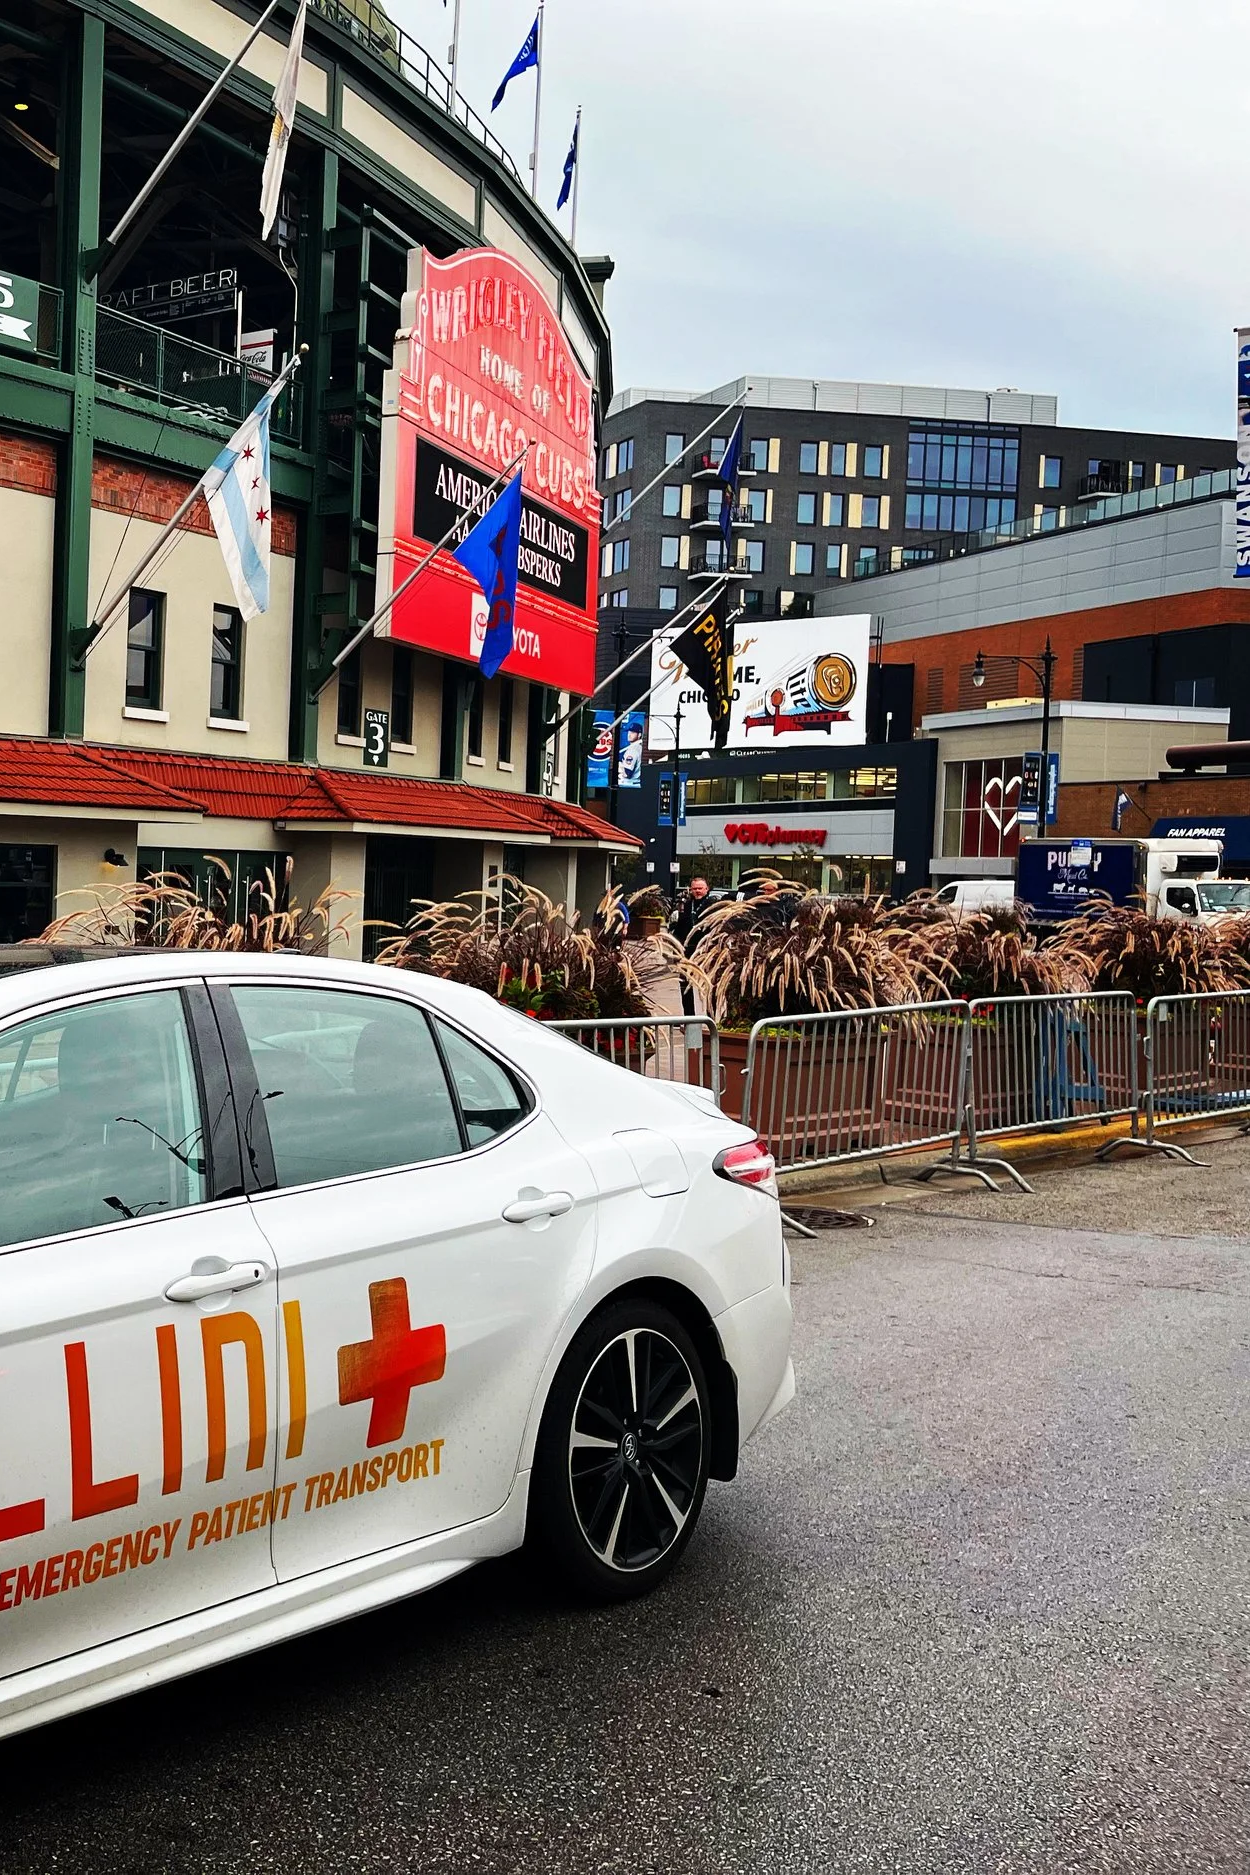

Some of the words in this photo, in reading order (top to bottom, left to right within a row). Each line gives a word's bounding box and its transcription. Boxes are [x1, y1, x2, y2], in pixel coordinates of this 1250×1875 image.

[100, 284, 159, 309] RAFT
[170, 268, 235, 298] BEER
[430, 275, 534, 344] WRIGLEY
[537, 313, 588, 440] FIELD
[479, 343, 525, 400] HOME
[531, 383, 551, 418] OF
[427, 372, 529, 471] CHICAGO
[535, 441, 586, 510] CUBS
[434, 463, 498, 518] AMERIC
[518, 506, 576, 563] AIRLINES
[517, 544, 562, 588] BSPERKS
[512, 624, 541, 660] YOTA
[678, 688, 741, 705] CHICO
[366, 711, 388, 725] GATE
[367, 723, 384, 755] 3
[782, 781, 815, 794] beauty
[1167, 828, 1186, 837] FAN
[1185, 827, 1226, 837] APPAREL
[1047, 851, 1102, 873] PUY
[187, 1482, 298, 1552] PATIENT
[303, 1438, 445, 1513] TRANSPORT
